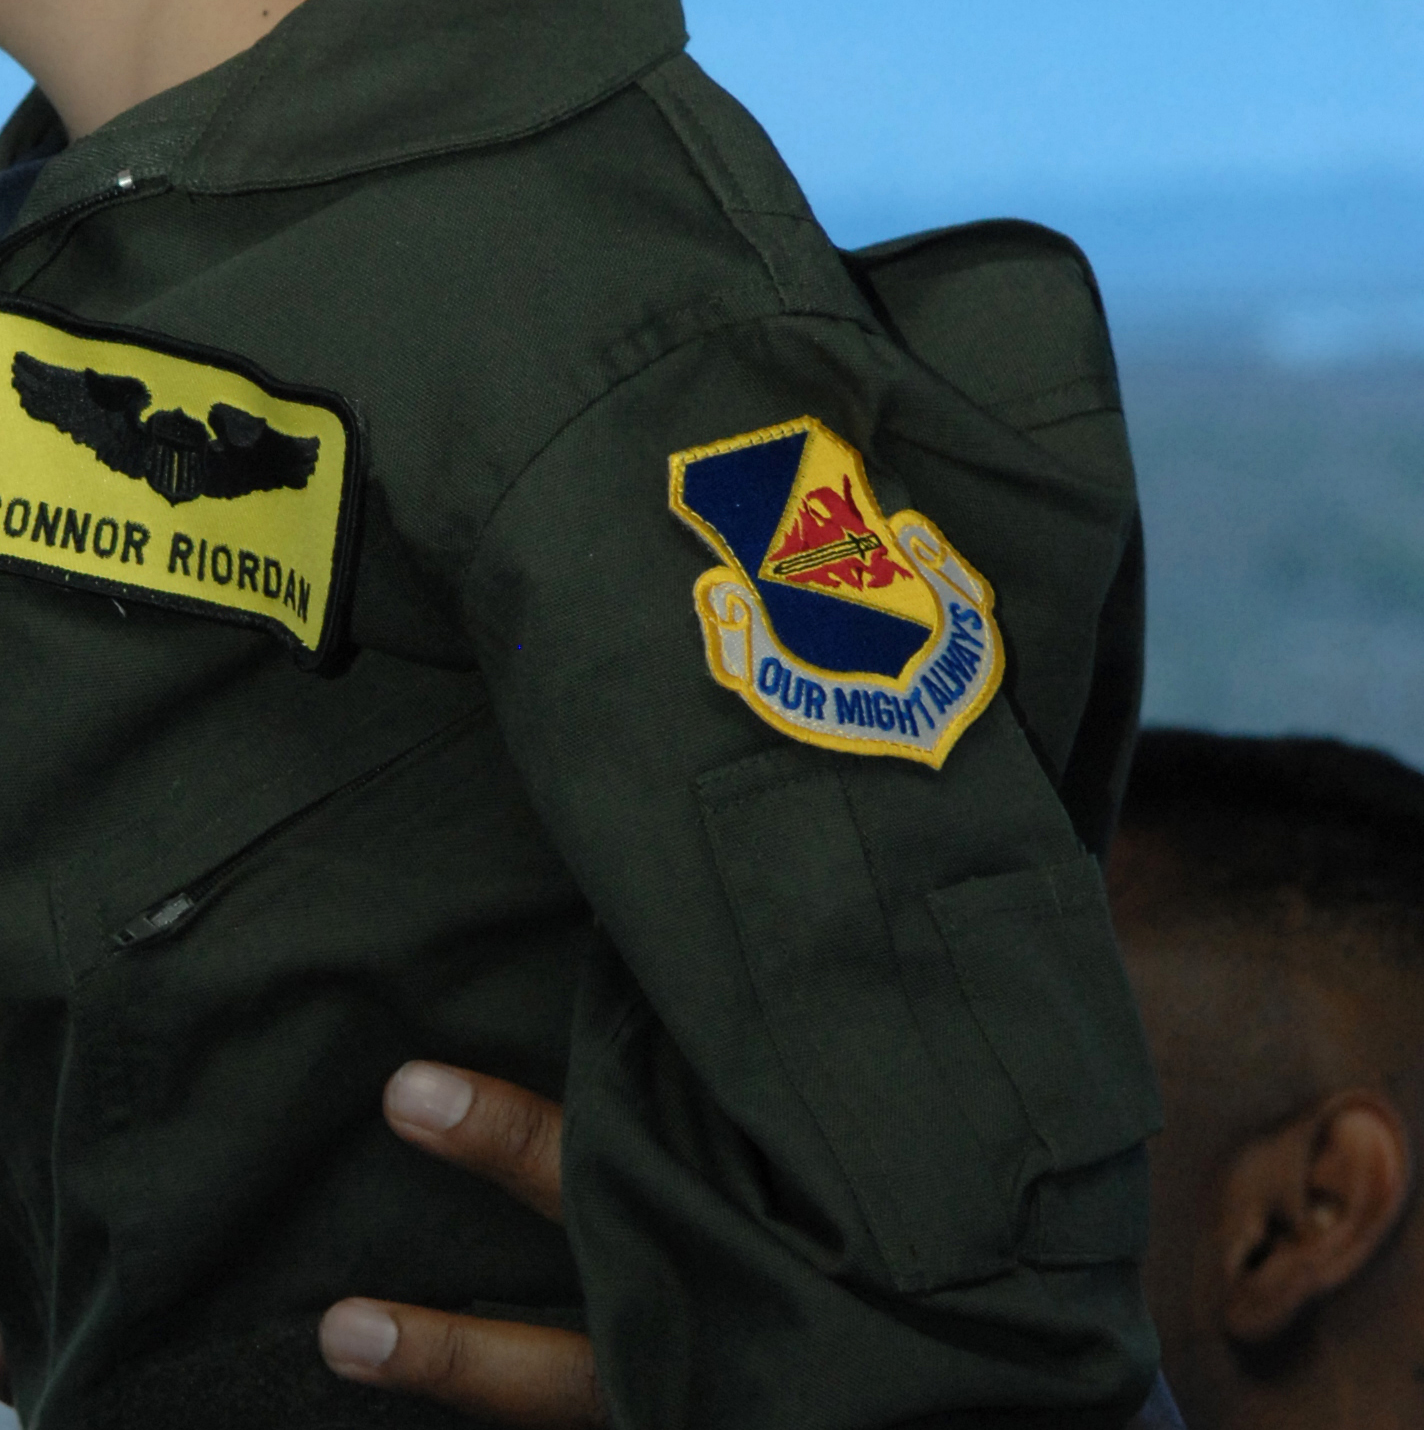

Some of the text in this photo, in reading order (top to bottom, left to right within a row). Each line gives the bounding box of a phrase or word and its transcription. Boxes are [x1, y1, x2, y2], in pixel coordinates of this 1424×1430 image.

[167, 532, 311, 624] RIORDAN
[757, 602, 984, 737] OUR MIGHT ALWAYS
